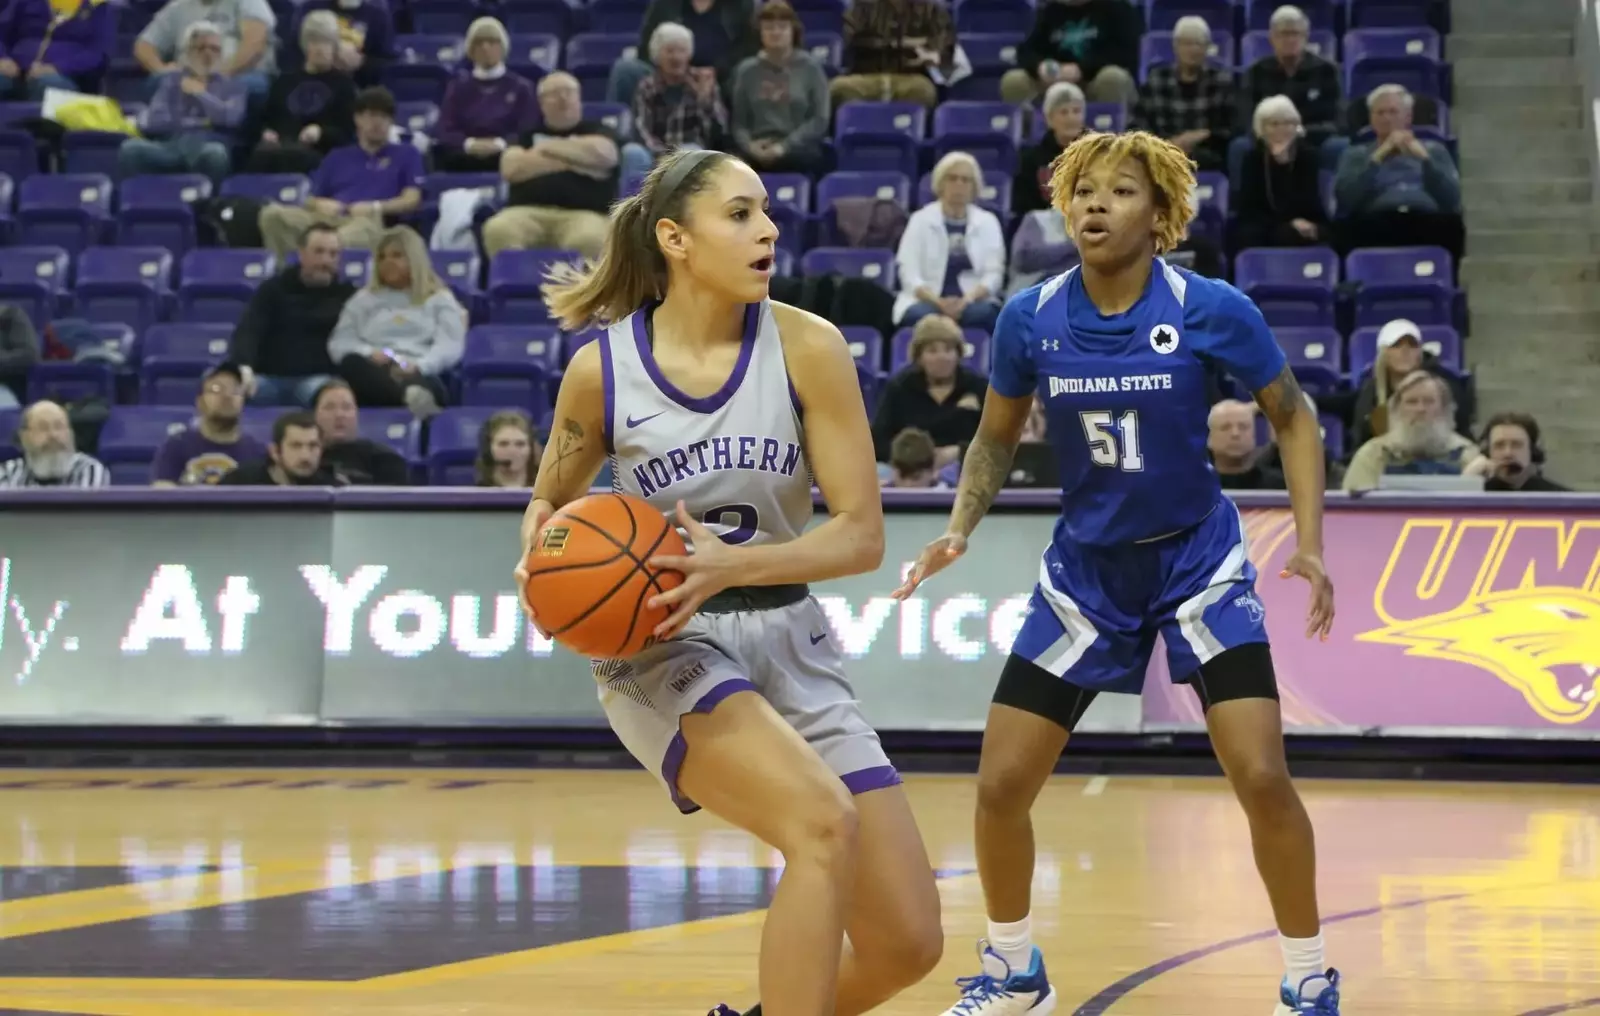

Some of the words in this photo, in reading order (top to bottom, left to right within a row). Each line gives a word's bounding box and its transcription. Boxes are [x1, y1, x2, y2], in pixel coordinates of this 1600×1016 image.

[1121, 374, 1172, 391] STATE
[632, 436, 801, 498] NORTHERN
[1078, 409, 1144, 472] 51
[1374, 518, 1600, 627] UN
[120, 563, 262, 655] At
[670, 661, 706, 693] VALLEY
